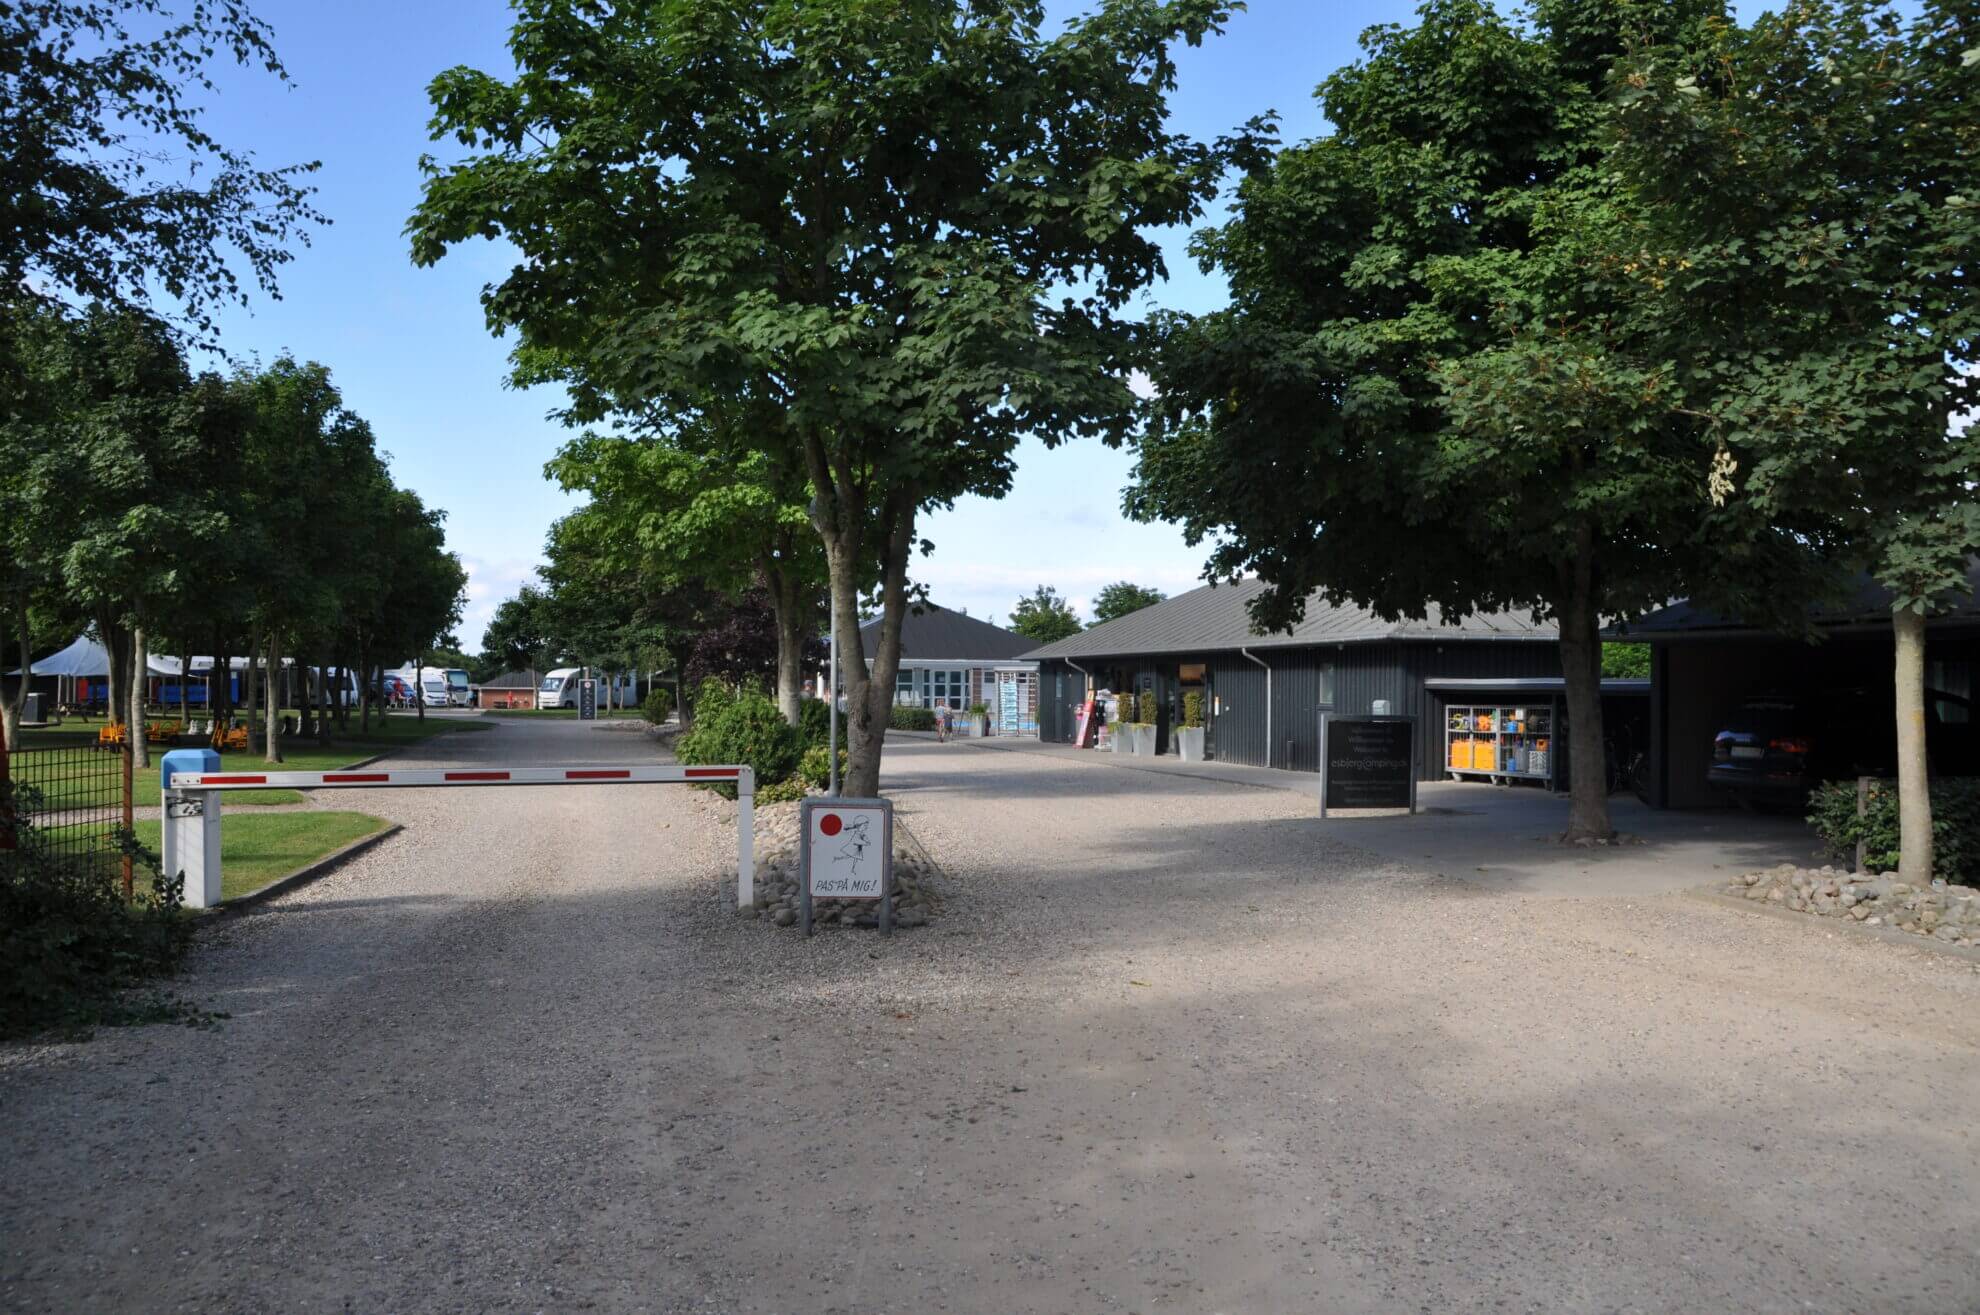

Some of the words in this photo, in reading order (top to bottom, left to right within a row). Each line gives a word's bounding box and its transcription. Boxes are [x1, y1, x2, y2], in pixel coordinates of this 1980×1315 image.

[815, 879, 834, 892] PAS
[836, 878, 849, 892] PÅ
[851, 879, 877, 892] MIG!
